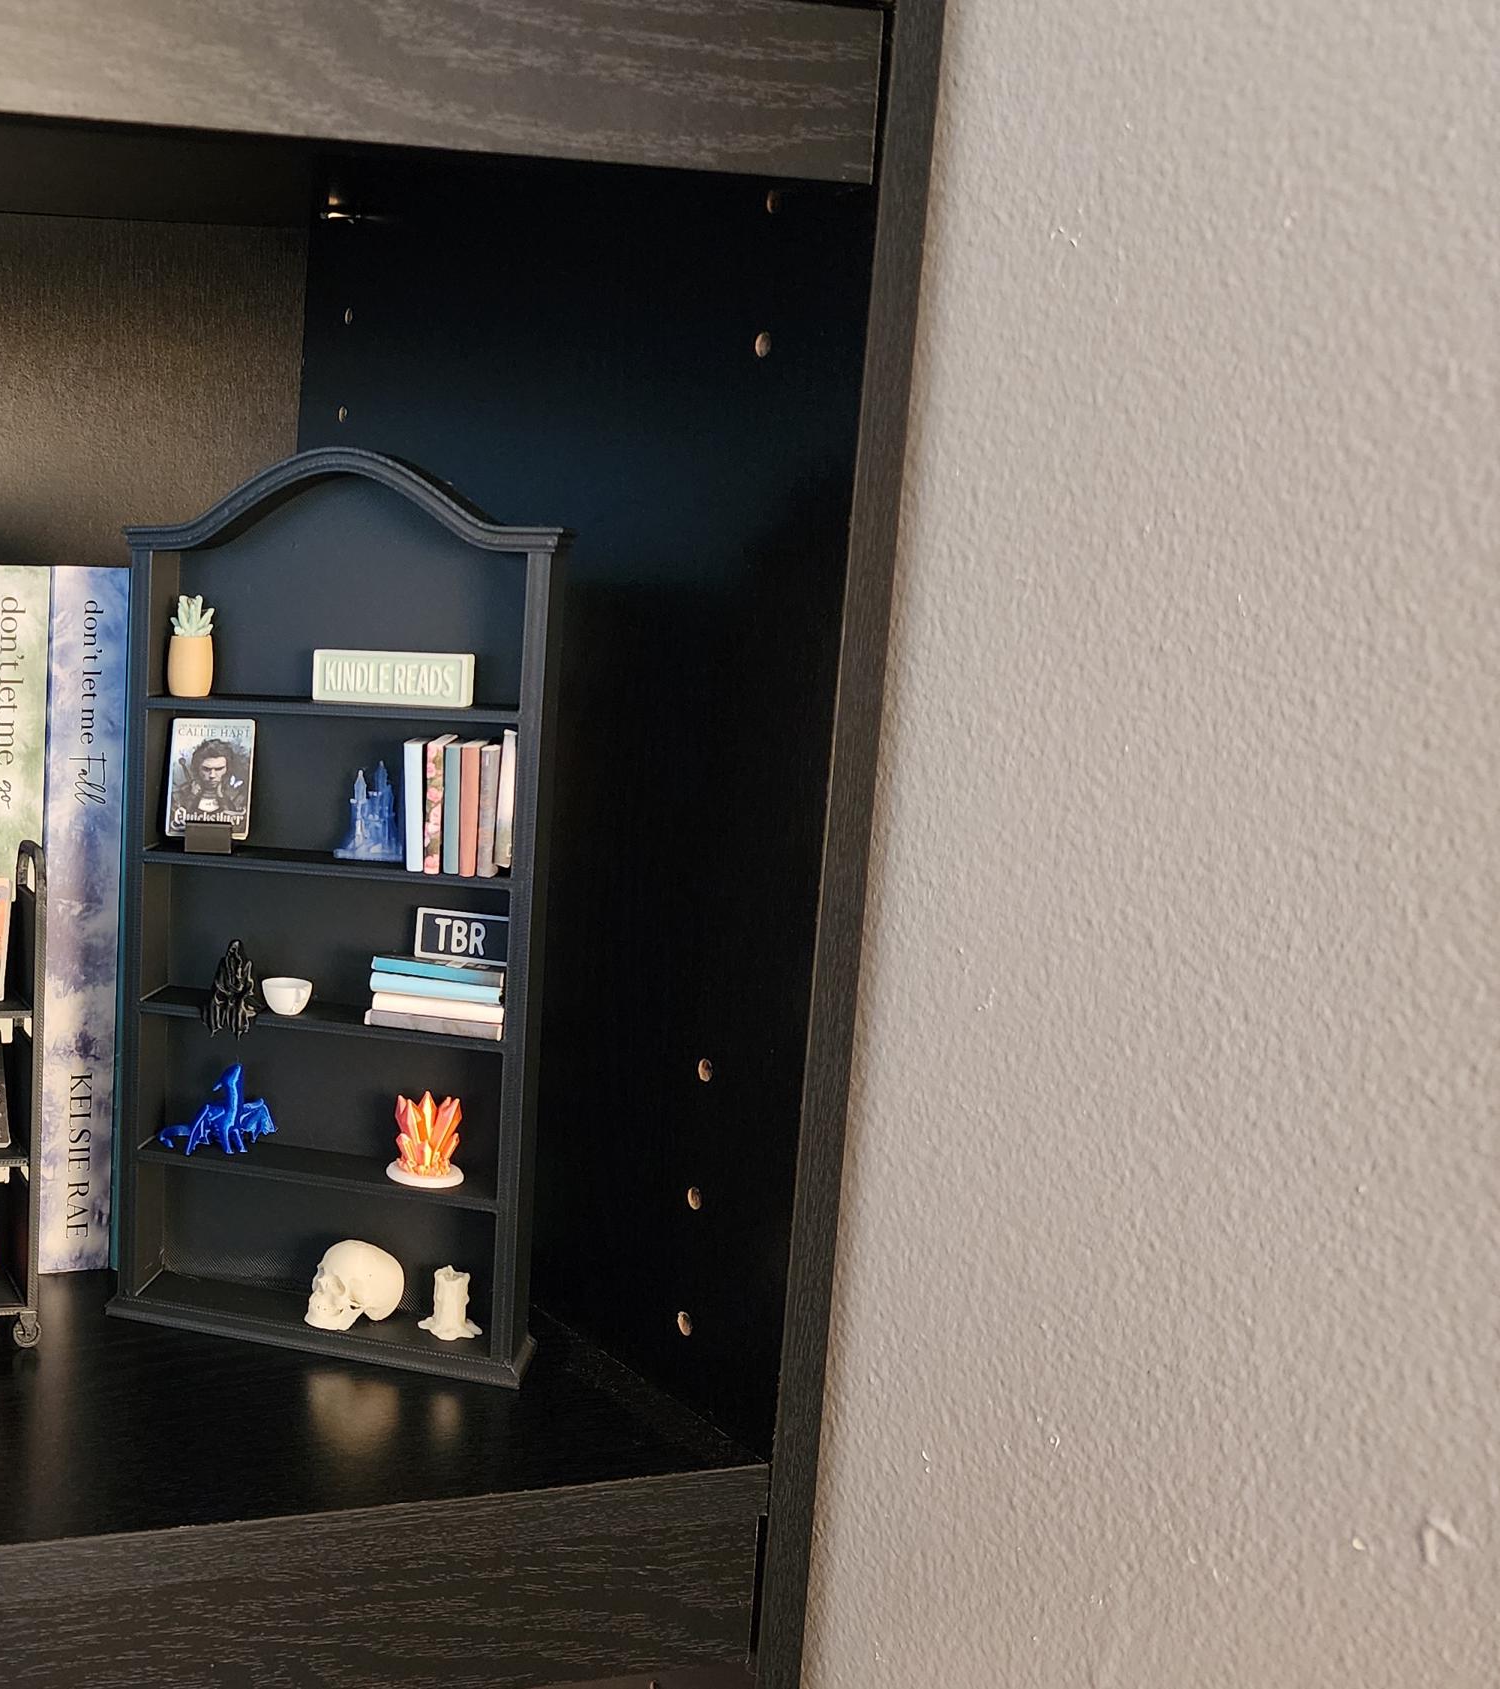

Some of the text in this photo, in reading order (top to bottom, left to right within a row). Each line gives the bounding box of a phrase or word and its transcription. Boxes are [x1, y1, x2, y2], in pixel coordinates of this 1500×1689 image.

[82, 669, 103, 701] let
[323, 661, 455, 698] KINDLE READS
[80, 706, 95, 745] me
[178, 727, 250, 738] CALLIE HART
[69, 751, 107, 807] Fall
[433, 917, 487, 956] TBR
[65, 1072, 93, 1240] KELSIE RAE
